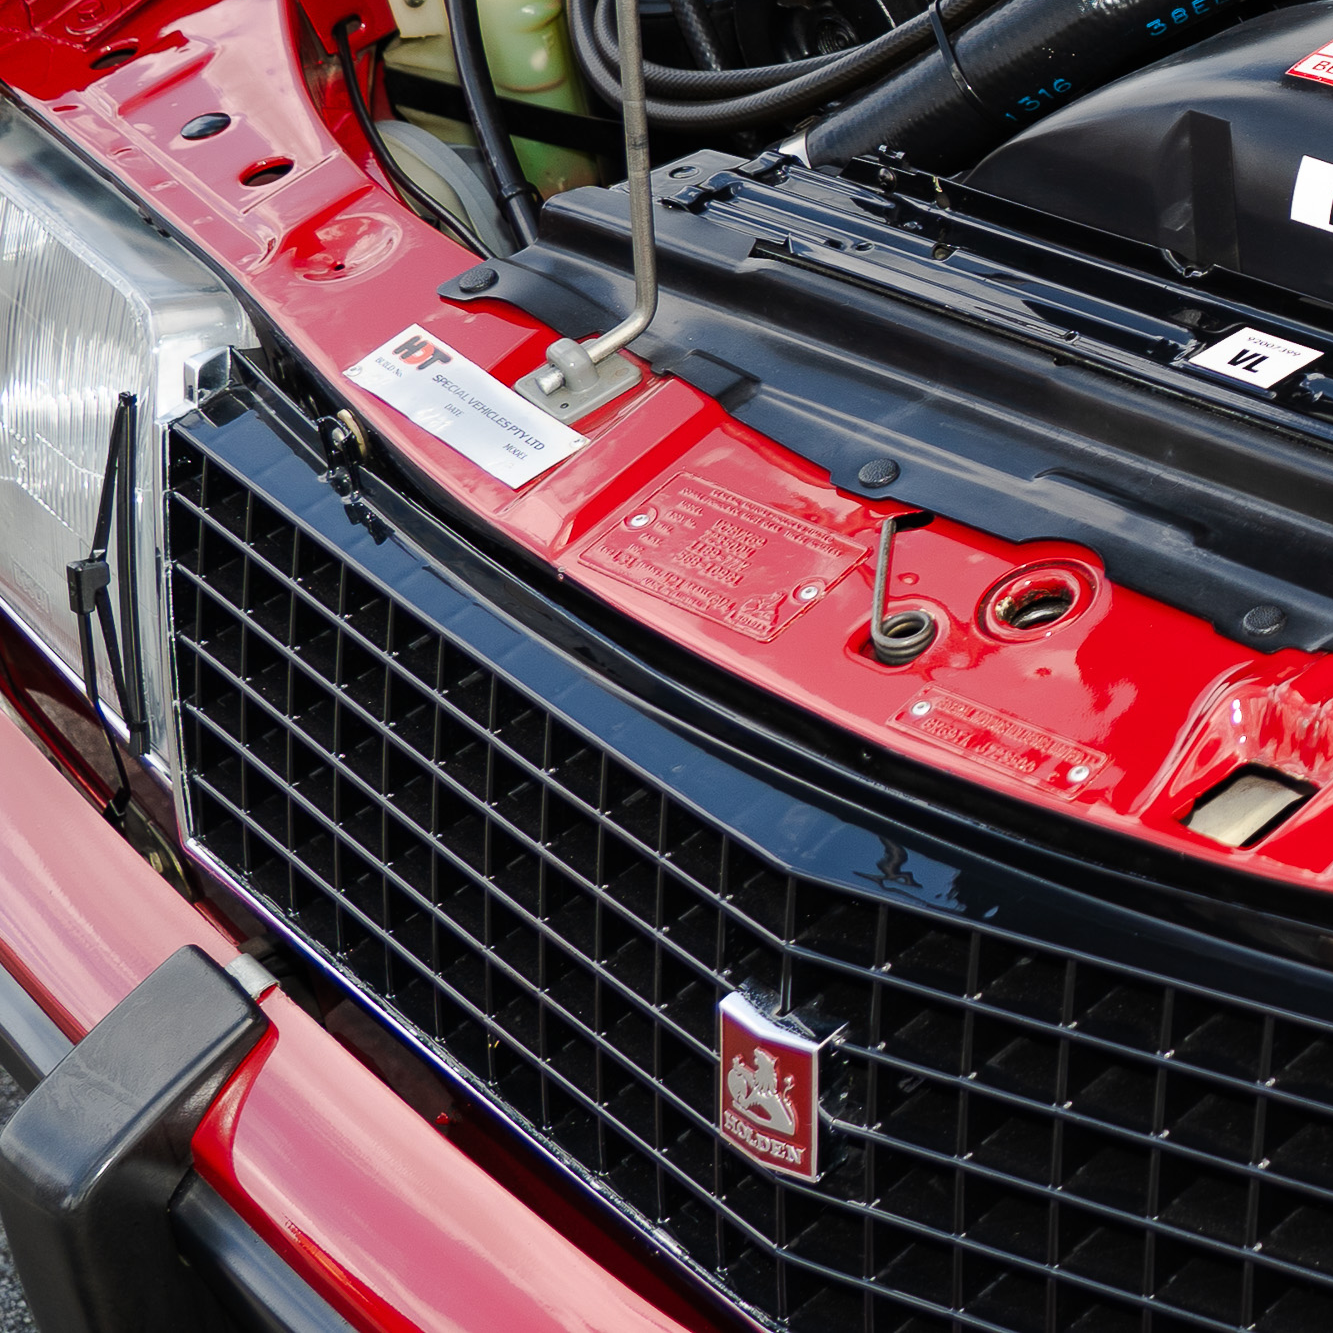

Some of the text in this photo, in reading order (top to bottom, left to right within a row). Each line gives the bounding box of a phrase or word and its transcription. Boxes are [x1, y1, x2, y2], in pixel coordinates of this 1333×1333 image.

[392, 334, 453, 371] HDT
[1227, 348, 1270, 374] VL
[432, 374, 546, 452] SPECIAL VEHICLES PTY LTD
[444, 403, 464, 418] DATE
[503, 443, 529, 461] MODEL
[724, 1110, 806, 1164] HOLDEN
